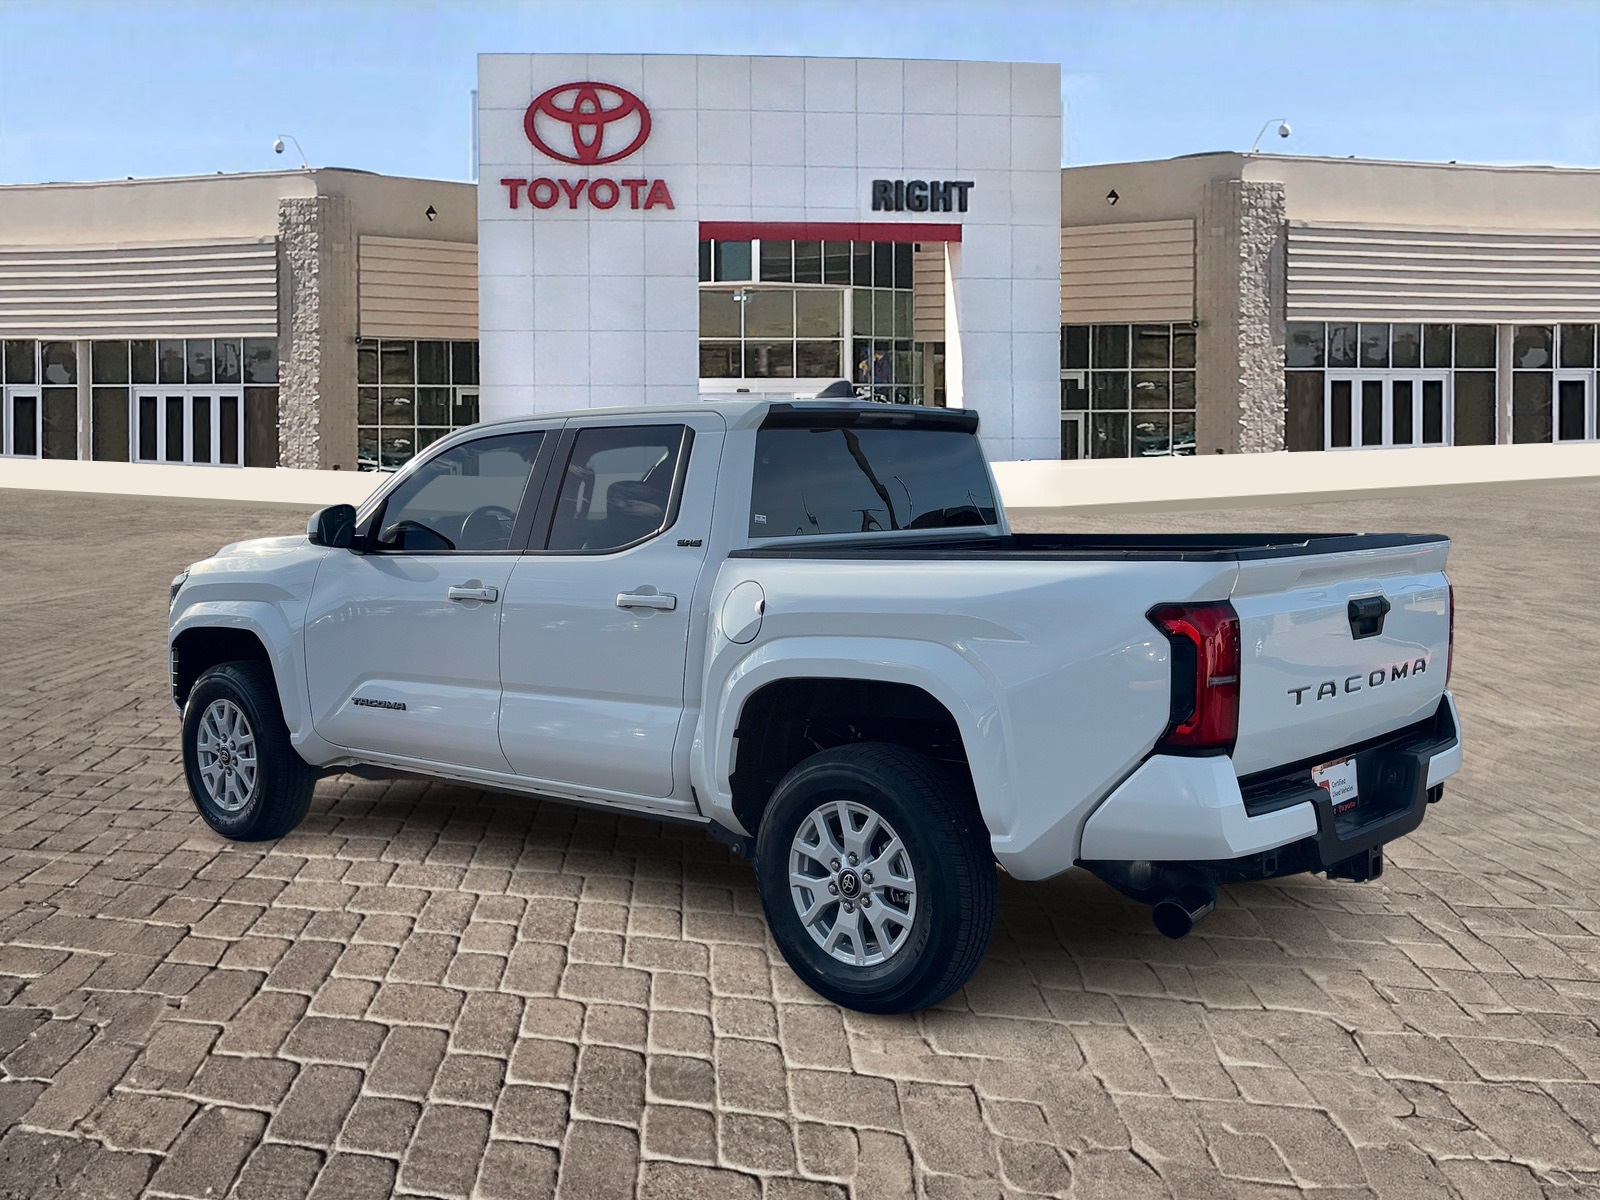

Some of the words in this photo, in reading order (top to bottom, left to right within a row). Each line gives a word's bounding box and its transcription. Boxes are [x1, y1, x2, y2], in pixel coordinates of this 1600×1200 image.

[500, 178, 675, 210] TOYOTA
[872, 179, 975, 212] RIGHT
[1287, 657, 1427, 706] TACOMA
[351, 697, 407, 711] TACOMA
[1332, 777, 1346, 788] Certified
